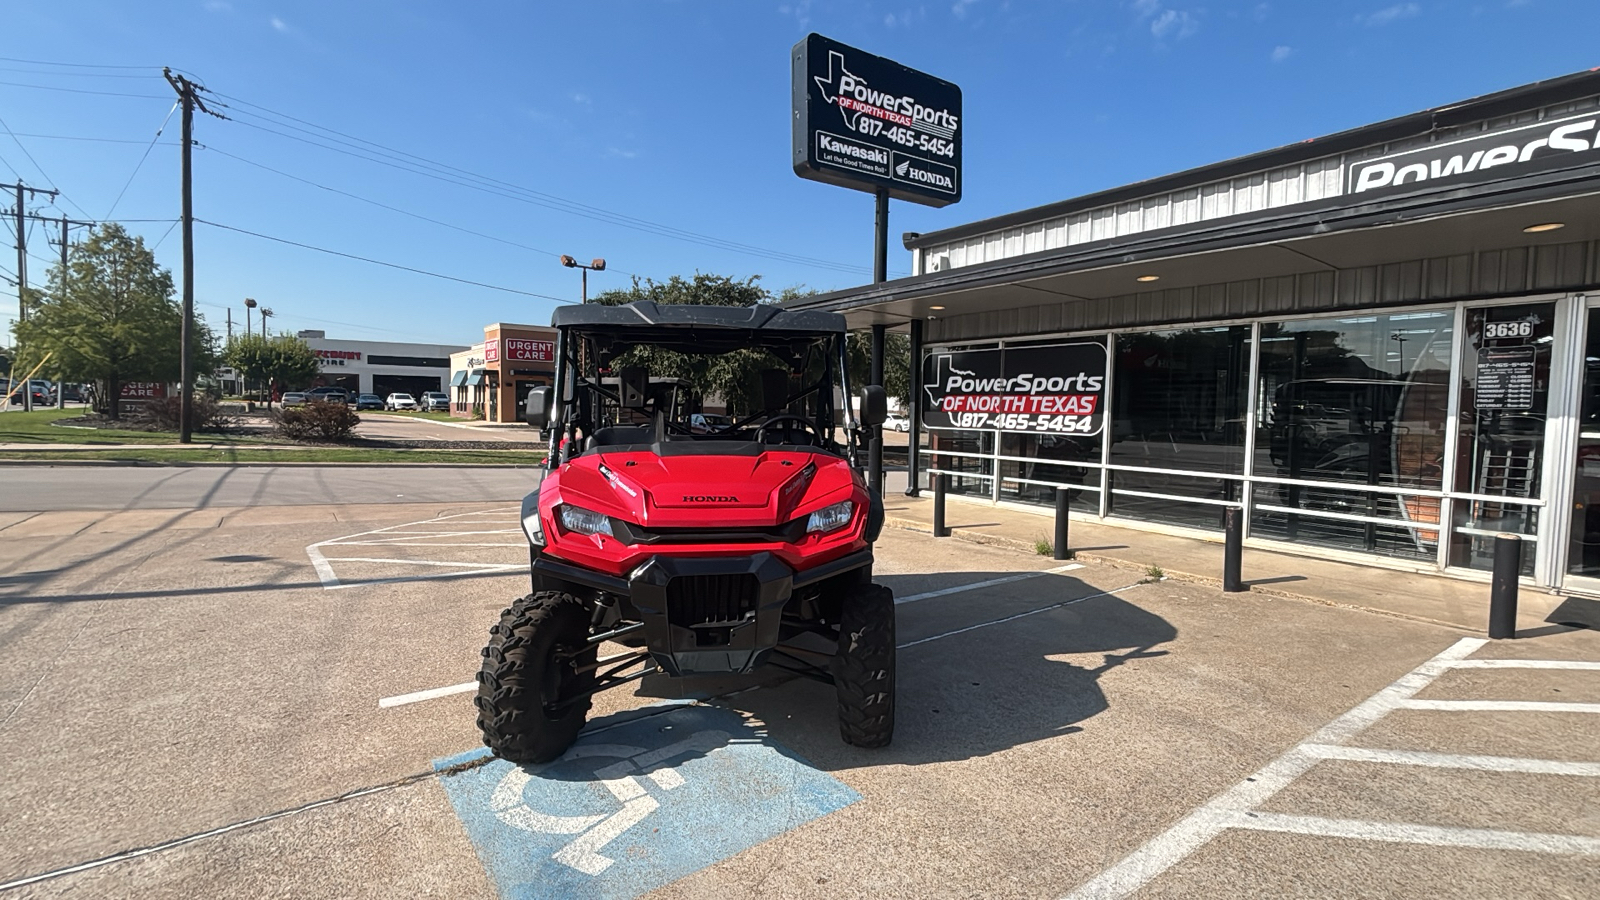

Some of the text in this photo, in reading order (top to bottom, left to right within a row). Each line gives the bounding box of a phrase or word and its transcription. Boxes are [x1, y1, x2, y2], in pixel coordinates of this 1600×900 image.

[838, 75, 958, 130] PowerSports
[839, 97, 911, 127] OF NORTH TEXAS
[859, 117, 955, 159] 817-465-5454
[820, 135, 888, 165] Kawasaki
[1354, 119, 1600, 193] PowerS
[823, 152, 833, 161] Let
[834, 154, 843, 163] the
[844, 157, 857, 168] Good
[858, 161, 874, 171] Times
[909, 167, 953, 188] HONDA
[1486, 322, 1531, 337] 3636
[485, 341, 498, 350] URGENT
[487, 350, 496, 359] CARE
[508, 341, 552, 351] URGENT
[516, 351, 546, 359] CARE
[121, 388, 154, 396] CARE
[945, 372, 1103, 395] PowerSports
[943, 395, 1093, 413] OF NORTH TEXAS
[961, 413, 1092, 432] 817-465-5454
[682, 495, 740, 503] HONDA
